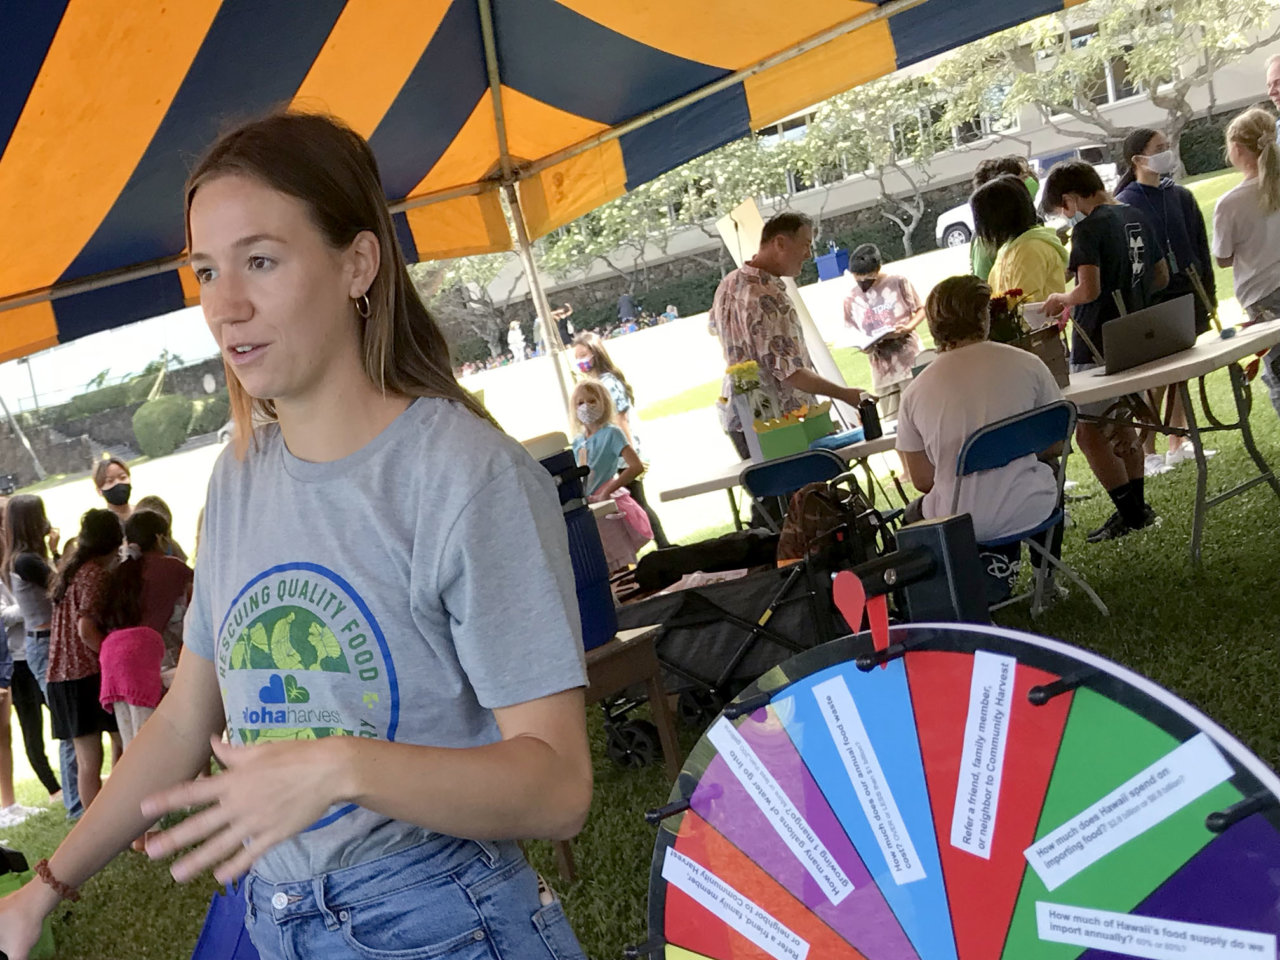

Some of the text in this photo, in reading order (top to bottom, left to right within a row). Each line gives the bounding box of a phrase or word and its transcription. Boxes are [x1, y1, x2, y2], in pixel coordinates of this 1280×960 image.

[276, 579, 347, 620] QUALITY
[340, 618, 380, 682] FOOD
[961, 815, 973, 845] Refer
[967, 806, 975, 814] a
[971, 734, 986, 768] family
[977, 662, 1009, 850] or neighbor to Community Harvest
